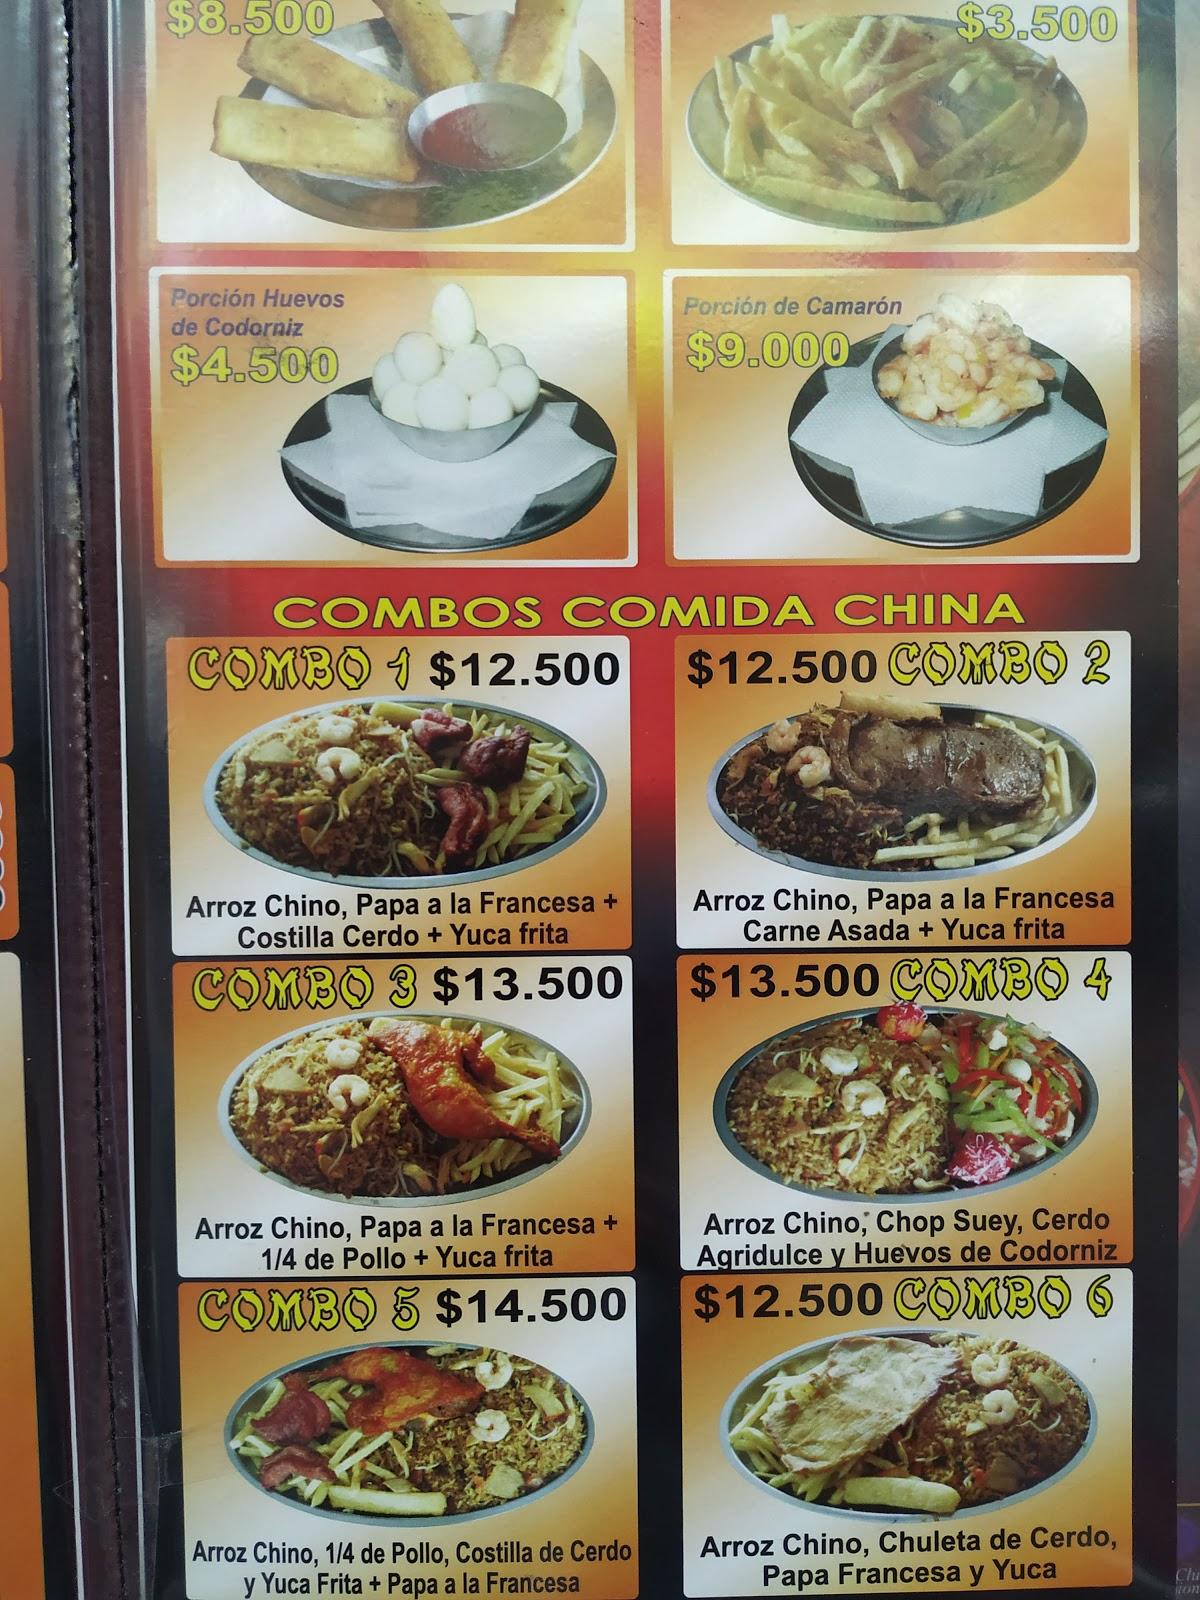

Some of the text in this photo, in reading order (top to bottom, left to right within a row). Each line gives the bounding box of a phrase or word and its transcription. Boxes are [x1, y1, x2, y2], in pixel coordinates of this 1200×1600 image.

[166, 0, 334, 39] $8.500
[956, 2, 1118, 43] $3.500
[171, 288, 345, 309] Porción Huevos
[683, 296, 902, 315] Porción de Camarón
[171, 318, 304, 338] de Codorniz
[170, 345, 339, 385] $4.500
[687, 329, 849, 371] $9.000
[272, 593, 1026, 630] COMBOS COMIDA CHINA
[187, 645, 620, 691] COMBO 1 $12.500
[687, 639, 1111, 688] $12.500 COMBO 2
[185, 891, 618, 921] Arroz Chino, Papa a la Francesa +
[693, 887, 1115, 915] Arroz Chino, Papa a la Francesa
[237, 922, 569, 950] Costilla Cerdo + Yuca frita
[743, 917, 1066, 943] Carne Asada + Yuca frita
[192, 964, 624, 1012] COMBO 3 $13.500
[690, 957, 1111, 1002] $13.500 COMBO 4
[195, 1213, 618, 1245] Arroz Chino, Papa a la Francesa +
[704, 1208, 1110, 1238] Arroz Chino, Chop Suey, Cerdo
[261, 1244, 553, 1271] 1/4 de Pollo + Yuca frita
[697, 1239, 1117, 1270] Agridulce y Huevos de Codorniz
[198, 1287, 627, 1332] COMBO 5 $14.500
[694, 1275, 1113, 1322] $12.500 COMBO 6
[192, 1539, 633, 1567] Arroz Chino, 1/4 de Pollo, Costilla de Cerdo
[701, 1528, 1117, 1560] Arroz Chino, Chuleta de Cerdo,
[244, 1573, 580, 1600] y Yuca Frita + Papa a la Francesa
[763, 1559, 1056, 1591] Papa Francesa y Yuca
